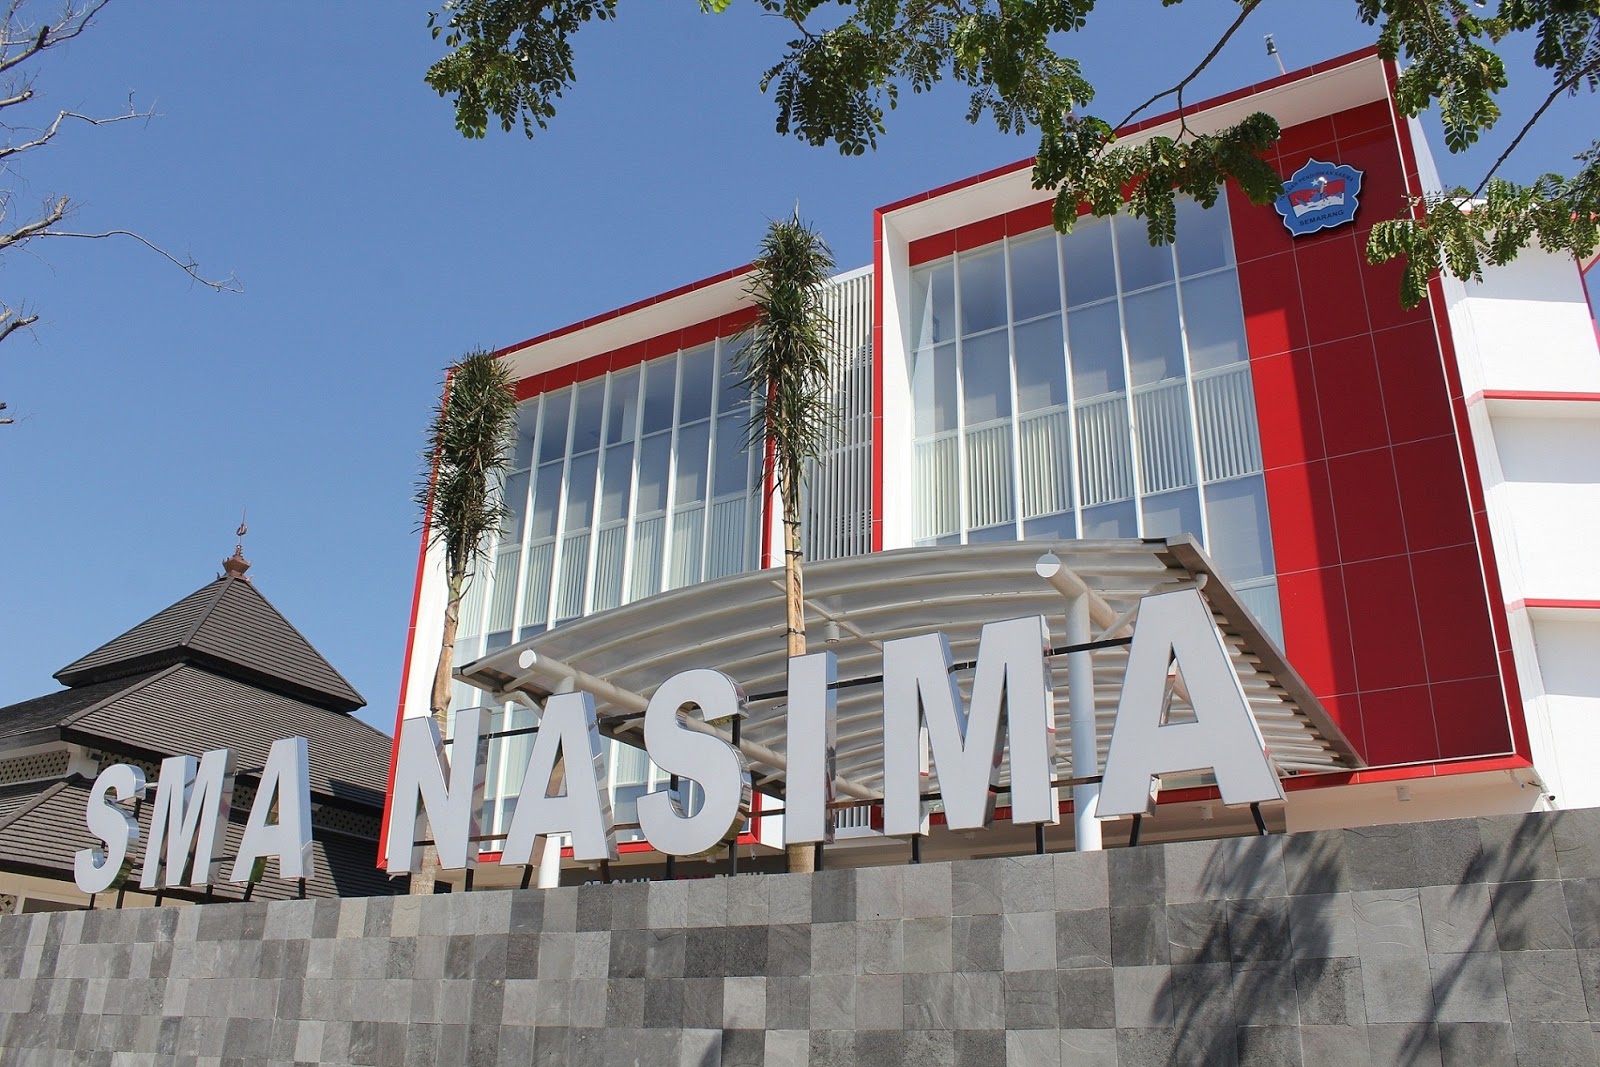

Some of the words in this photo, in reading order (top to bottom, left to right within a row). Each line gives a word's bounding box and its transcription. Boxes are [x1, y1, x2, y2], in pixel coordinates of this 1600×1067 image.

[1279, 182, 1298, 201] YAASAN
[1299, 209, 1344, 226] SEMARANG
[74, 736, 314, 894] SMA
[386, 588, 1284, 874] NASIMA
